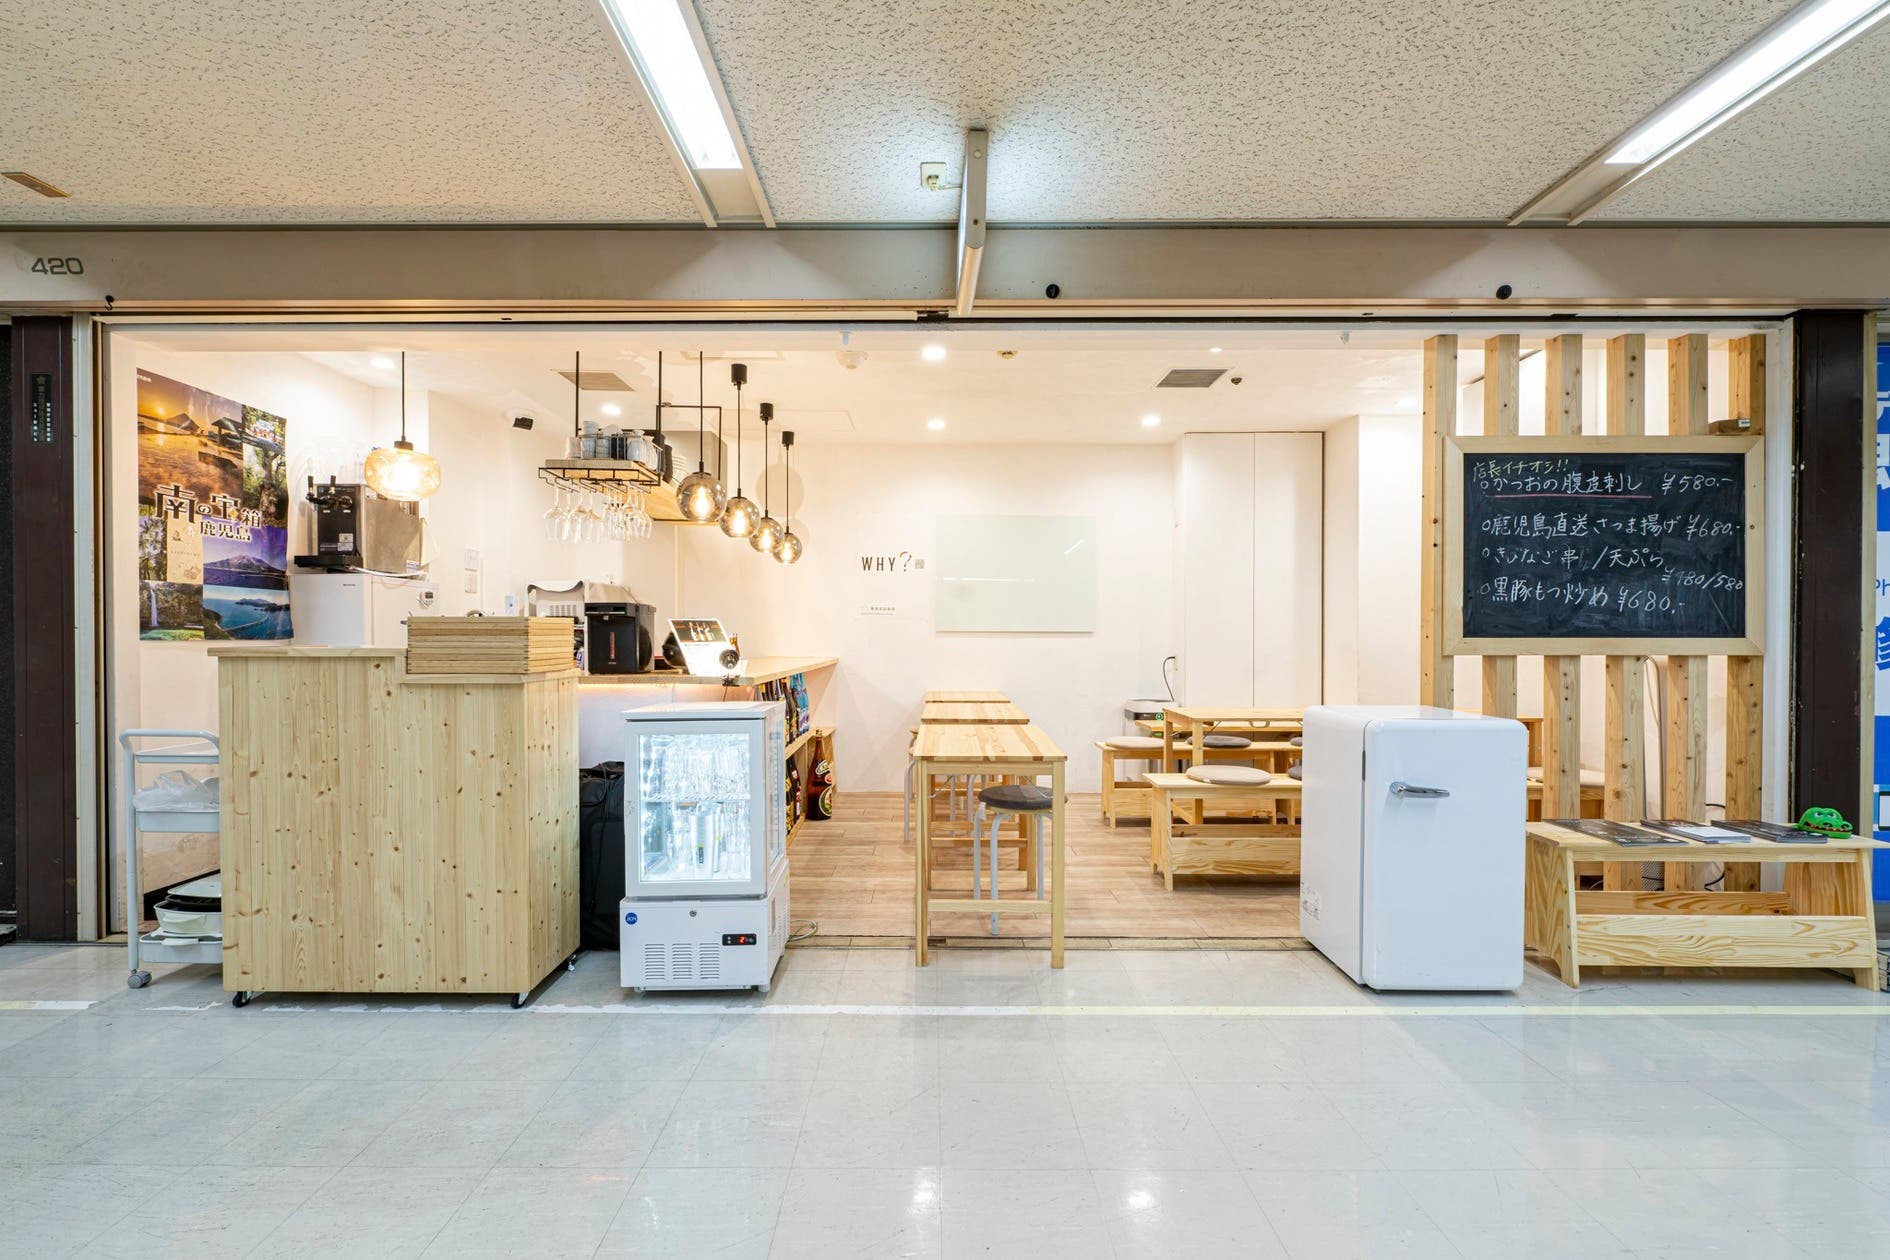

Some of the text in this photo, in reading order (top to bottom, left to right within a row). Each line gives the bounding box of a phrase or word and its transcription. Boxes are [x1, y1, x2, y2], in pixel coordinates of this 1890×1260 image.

[32, 257, 84, 275] 420
[200, 520, 252, 542] 鹿児島
